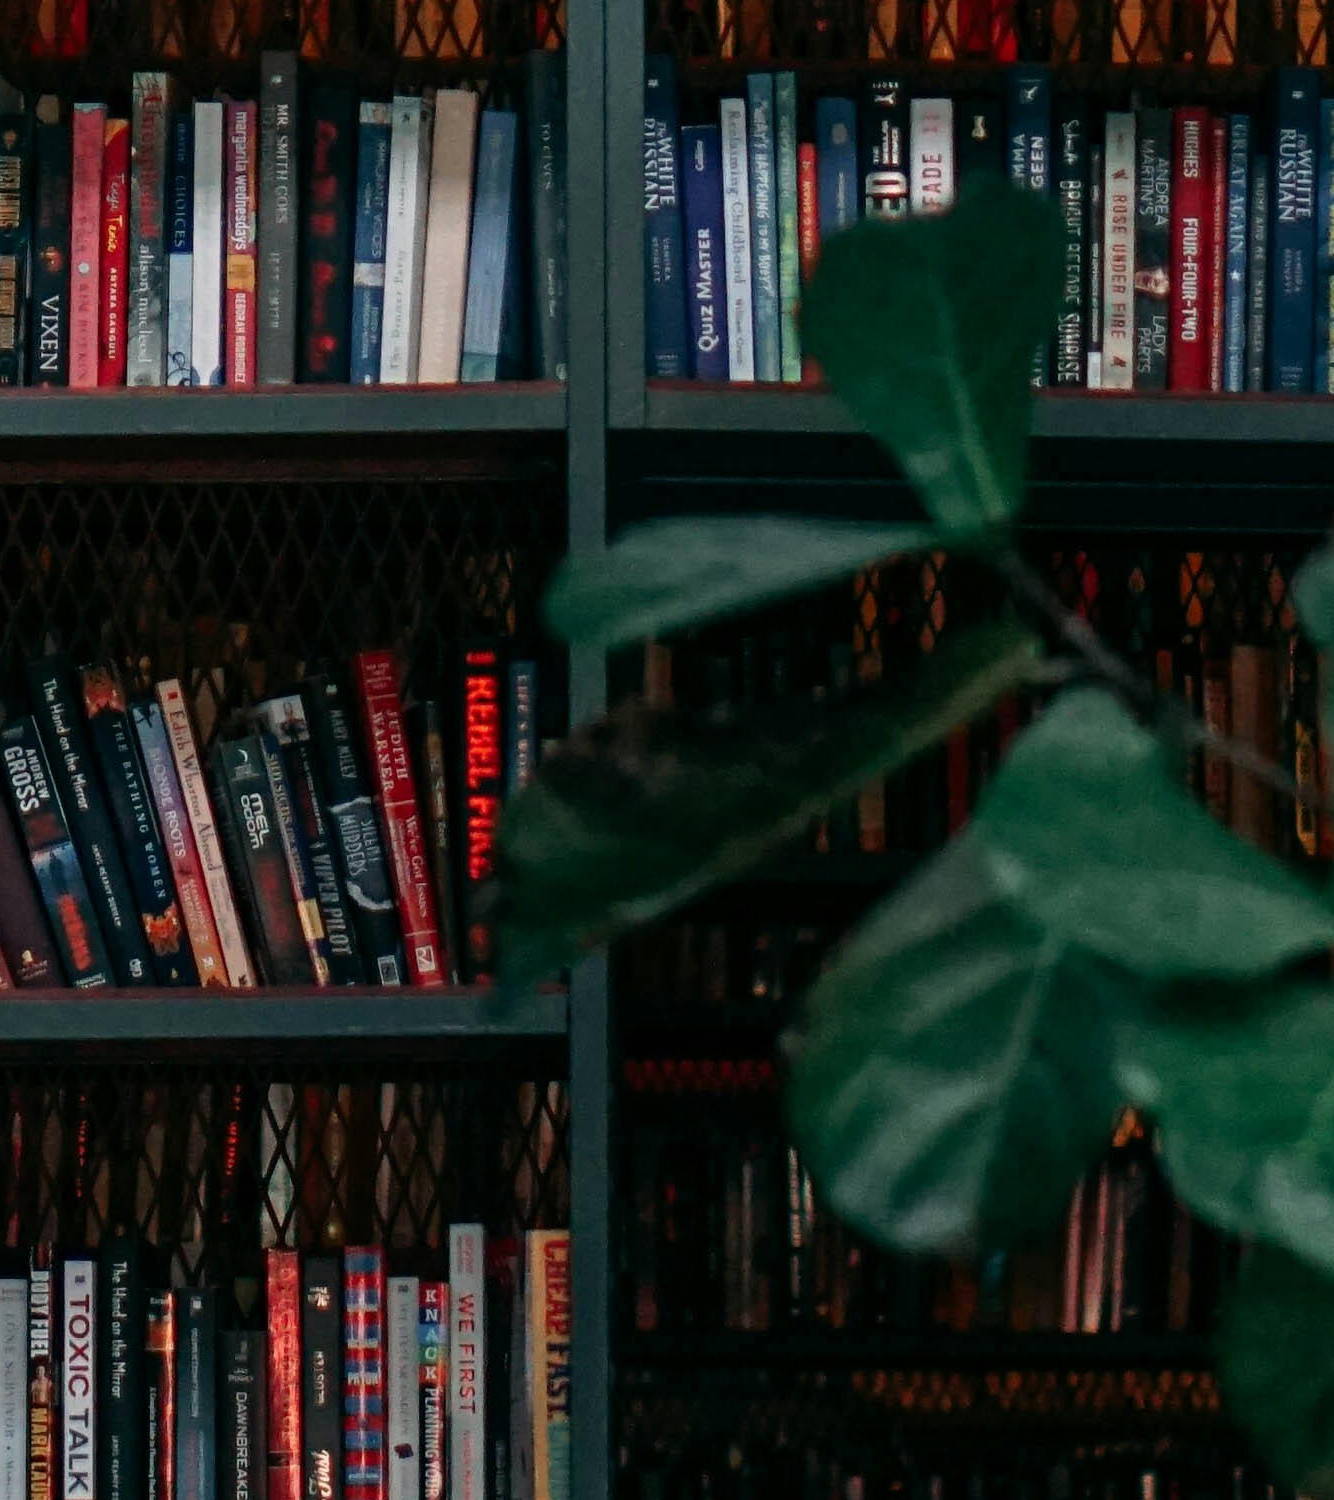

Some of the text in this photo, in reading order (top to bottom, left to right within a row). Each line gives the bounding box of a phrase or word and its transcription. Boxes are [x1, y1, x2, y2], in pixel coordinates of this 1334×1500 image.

[232, 112, 250, 250] margarita wednesdays
[1183, 121, 1198, 178] HUGHES
[1278, 129, 1296, 221] RUSSIAN
[1181, 218, 1198, 341] FOUR-FOUR-TWO
[39, 295, 60, 371] VIXEN
[3, 745, 40, 813] GROSS
[68, 1295, 90, 1493] TOXIC TALK
